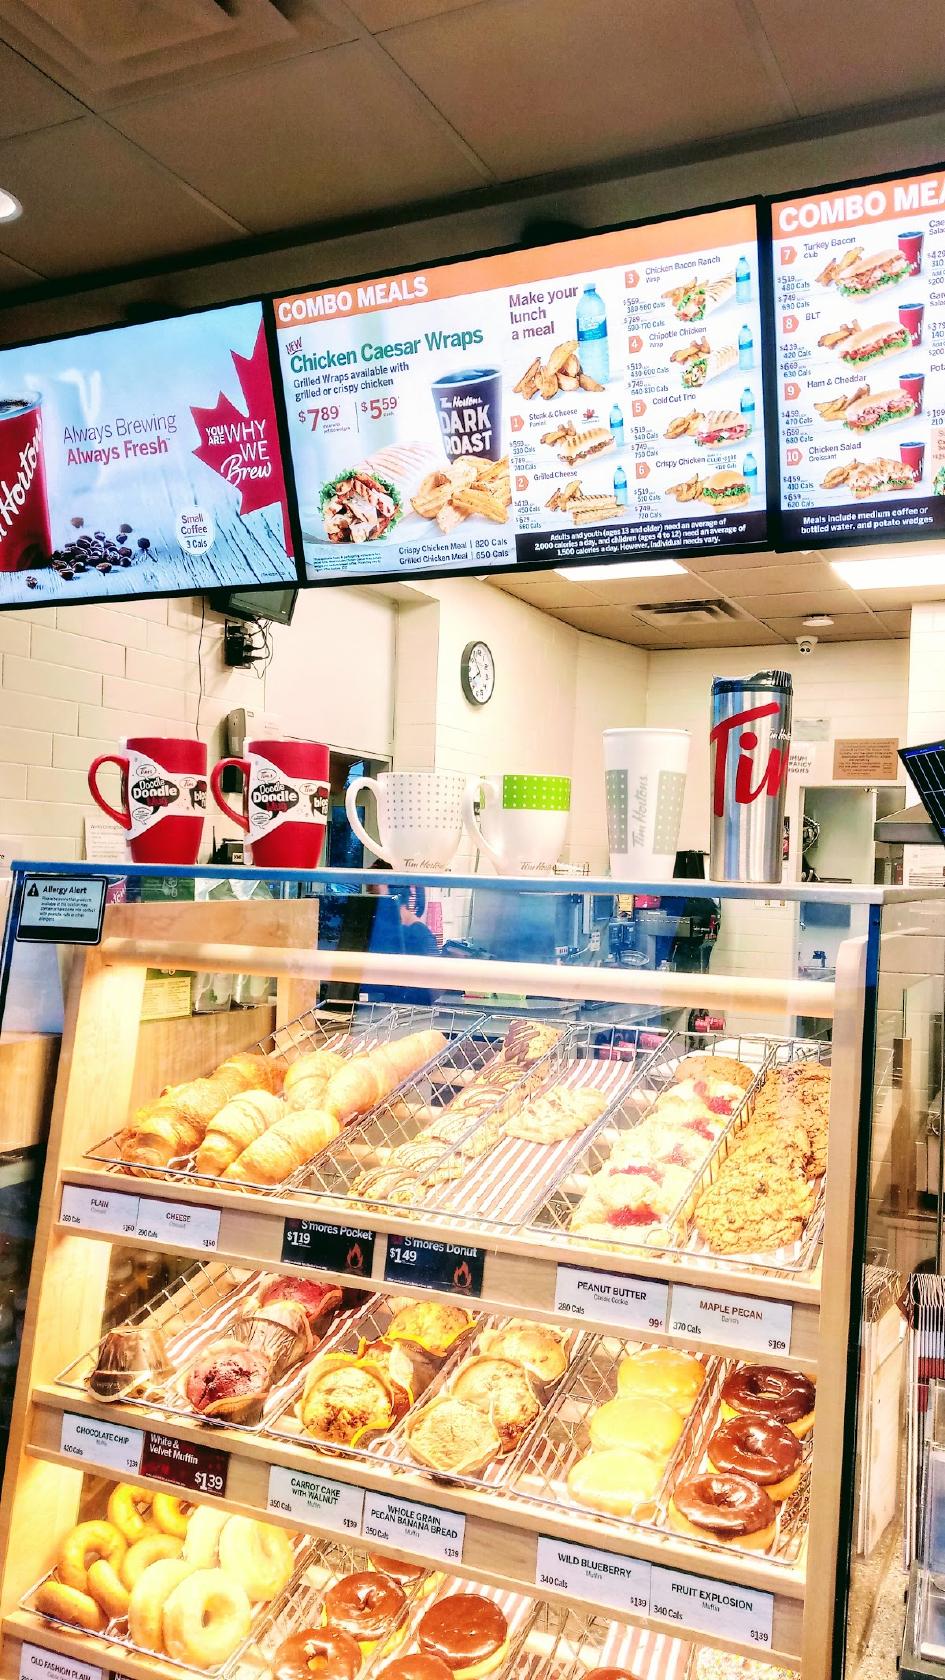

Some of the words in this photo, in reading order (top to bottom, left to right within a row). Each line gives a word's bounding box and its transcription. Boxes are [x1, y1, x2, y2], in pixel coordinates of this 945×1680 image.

[779, 191, 886, 232] COMBO
[804, 242, 829, 250] Turkey
[831, 237, 856, 246] Bacon
[646, 264, 673, 275] Chicken
[674, 261, 696, 270] Bacon
[698, 256, 720, 265] Ranch
[278, 290, 353, 322] COMBO
[357, 276, 429, 308] MEALS
[509, 292, 544, 308] Make
[548, 287, 578, 304] your
[510, 307, 546, 324] lunch
[806, 312, 821, 320] BLT
[512, 331, 519, 340] a
[523, 321, 554, 339] meal
[649, 331, 678, 341] Chipotle
[679, 326, 707, 335] Chicken
[291, 349, 357, 373] Chicken
[361, 339, 421, 362] Caesar
[425, 328, 484, 350] Wraps
[294, 377, 321, 388] Grilled
[322, 372, 349, 384] Wraps
[351, 366, 389, 379] available
[390, 362, 409, 373] with
[808, 380, 825, 388] Ham
[835, 375, 867, 384] Cheddar
[295, 388, 321, 401] grilled
[323, 387, 331, 395] or
[333, 382, 358, 394] crispy
[361, 378, 394, 390] chicken
[653, 397, 667, 405] Cold
[669, 395, 682, 403] Cut
[439, 405, 491, 433] DARK
[529, 412, 548, 421] Steak
[554, 408, 578, 417] Cheese
[63, 423, 113, 444] Always
[117, 413, 177, 437] Brewing
[206, 425, 224, 435] YOU
[224, 419, 265, 443] WHY
[208, 435, 225, 445] ARE
[443, 430, 492, 454] ROAST
[67, 445, 120, 466] Always
[240, 440, 269, 462] WE
[809, 445, 838, 454] Chicken
[840, 442, 861, 451] Salad
[656, 458, 677, 467] Crispy
[679, 457, 706, 466] Chicken
[809, 454, 836, 462] Croissant
[221, 454, 272, 486] Brew
[534, 473, 553, 481] Grilled
[181, 513, 203, 524] Small
[803, 516, 825, 524] Meals
[828, 513, 856, 522] include
[858, 510, 890, 519] medium
[892, 508, 918, 516] coffee
[181, 524, 208, 534] Coffee
[801, 524, 829, 534] bottled
[831, 523, 855, 531] water,
[874, 519, 900, 528] potato
[902, 516, 933, 525] wedges
[192, 539, 207, 548] Cals
[399, 546, 420, 554] Crispy
[422, 542, 448, 552] Chicken
[451, 540, 466, 550] Meal
[476, 539, 489, 548] 820
[492, 538, 508, 546] Cals
[399, 555, 421, 564] Grilled
[423, 553, 450, 562] Chicken
[451, 552, 468, 560] Meal
[133, 785, 178, 798] Doodle
[139, 778, 165, 791] Doodle
[259, 783, 286, 794] Doodle
[253, 791, 298, 803] Doodle
[633, 774, 649, 823] Hortons
[631, 829, 646, 849] Tim
[404, 858, 419, 868] Tim
[43, 886, 67, 894] Allergy
[91, 1199, 109, 1208] PLAIN
[166, 1212, 191, 1222] CHEESE
[287, 1231, 310, 1245] $119
[302, 1220, 338, 1235] S'mores
[340, 1226, 373, 1241] Pocket
[405, 1237, 444, 1252] S'mores
[447, 1243, 478, 1258] Donut
[389, 1248, 417, 1263] $149
[577, 1281, 611, 1294] PEANUT
[613, 1288, 647, 1301] BUTTER
[594, 1293, 610, 1303] Classic
[612, 1297, 628, 1305] Cookie
[558, 1302, 571, 1312] 280
[571, 1305, 585, 1315] Cals
[700, 1301, 730, 1314] MAPLE
[732, 1307, 763, 1321] PECAN
[648, 1318, 663, 1328] 99¢
[673, 1322, 686, 1332] 370
[687, 1324, 701, 1334] Cals
[769, 1340, 786, 1350] $169
[76, 1426, 113, 1441] CHOCOLATE
[114, 1436, 129, 1445] CHIP
[150, 1433, 172, 1446] White
[173, 1440, 179, 1449] &
[73, 1447, 83, 1455] Cals
[150, 1444, 172, 1458] Velvet
[173, 1451, 198, 1464] Muffin
[195, 1472, 223, 1491] $139
[291, 1478, 319, 1493] CARROT
[321, 1486, 340, 1497] CAKE
[292, 1488, 306, 1497] WITH
[308, 1492, 338, 1505] WALNUT
[270, 1500, 280, 1508] 350
[281, 1503, 291, 1512] Cals
[388, 1504, 415, 1518] WHOLE
[416, 1512, 441, 1525] GRAIN
[344, 1519, 357, 1528] $139
[372, 1510, 396, 1522] PECAN
[398, 1516, 430, 1531] BANANA
[431, 1525, 457, 1539] BREAD
[366, 1526, 377, 1536] 350
[377, 1530, 389, 1540] Cals
[558, 1553, 579, 1565] WILD
[581, 1559, 631, 1579] BLUEBERRY
[540, 1574, 553, 1584] 340
[554, 1578, 568, 1589] Cals
[631, 1597, 646, 1607] $139
[671, 1583, 697, 1597] FRUIT
[700, 1590, 753, 1611] EXPLOSION
[654, 1605, 667, 1616] 340
[668, 1609, 683, 1620] Cals
[750, 1630, 768, 1641] $139
[31, 1656, 43, 1666] OLD
[44, 1661, 70, 1676] FASHION
[72, 1670, 90, 1680] PLAIN
